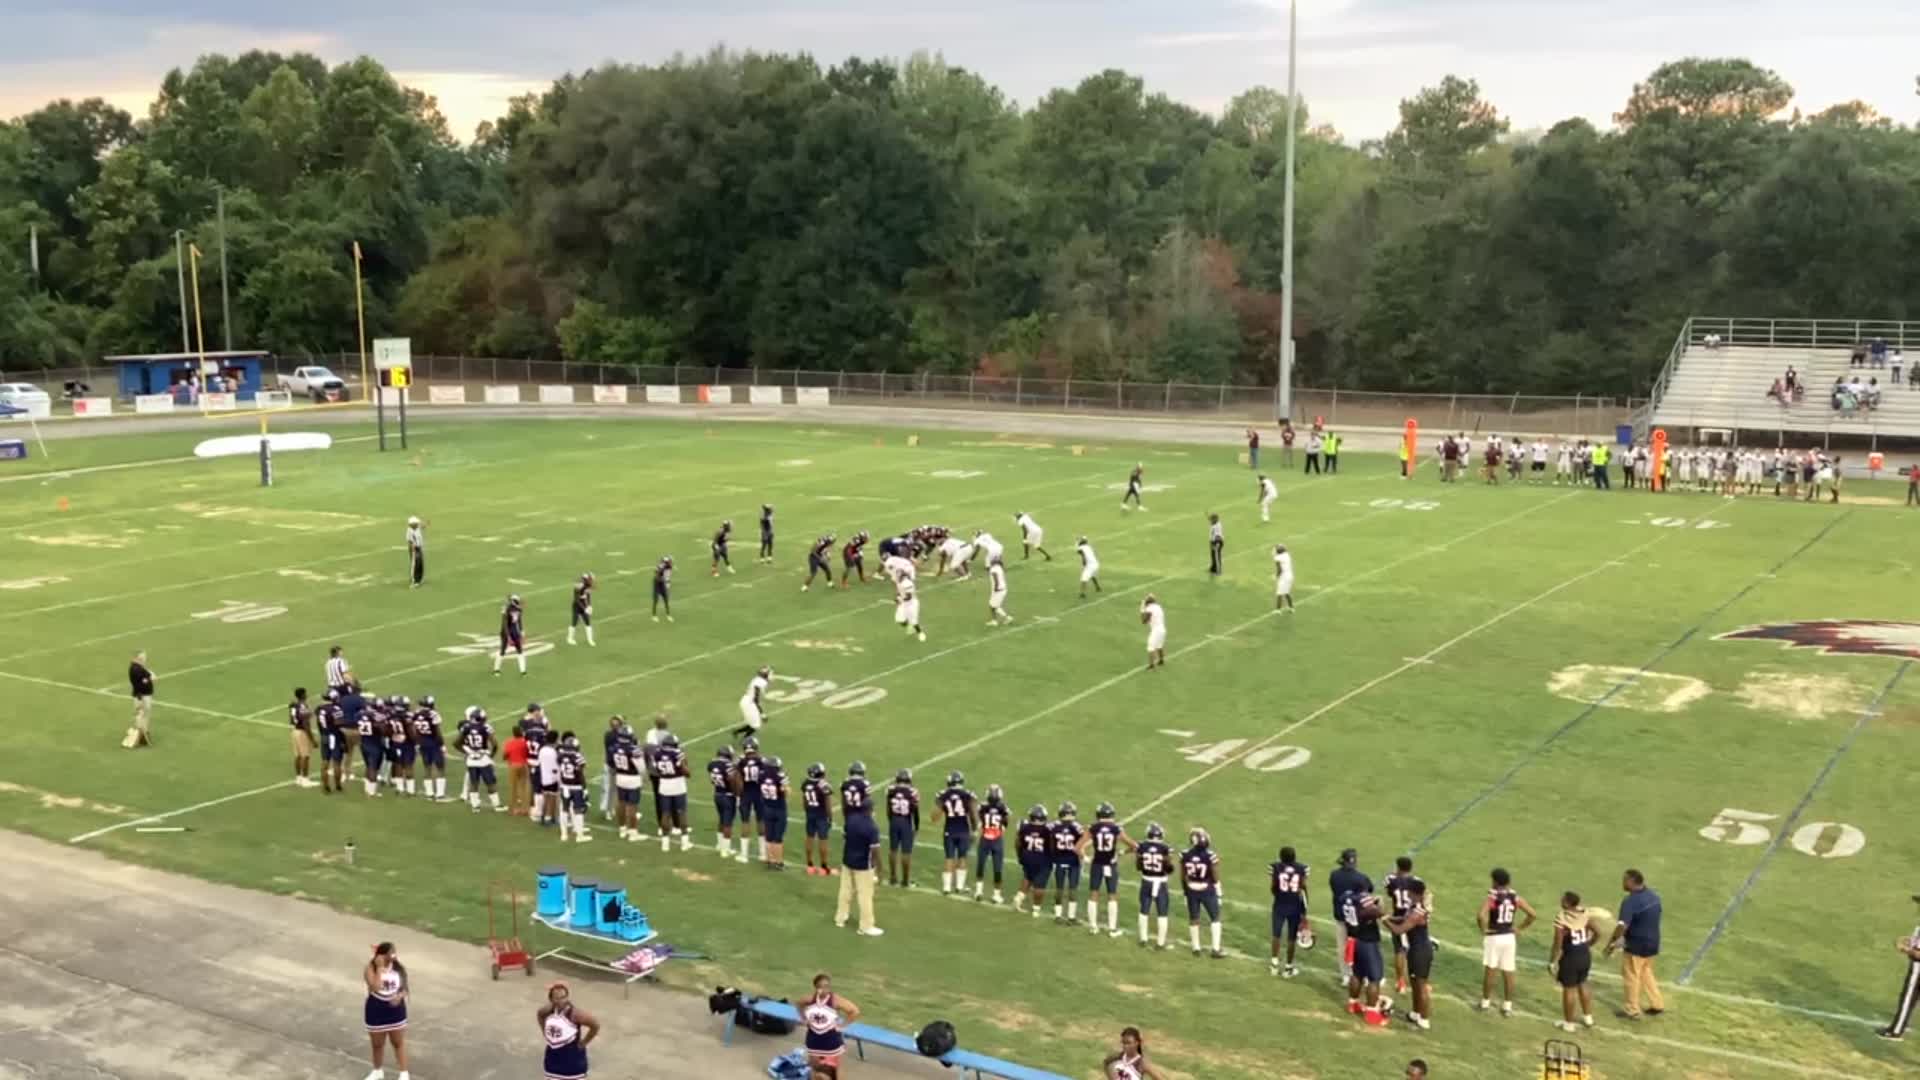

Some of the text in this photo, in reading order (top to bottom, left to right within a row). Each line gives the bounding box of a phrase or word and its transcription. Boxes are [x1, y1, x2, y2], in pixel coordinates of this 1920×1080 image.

[766, 679, 887, 709] 30
[1176, 738, 1311, 772] 40
[945, 800, 965, 817] 14
[984, 814, 1002, 828] 15
[1096, 833, 1114, 851] 13
[1699, 808, 1866, 857] 50
[1142, 852, 1163, 872] 25
[1185, 863, 1207, 878] 27
[1279, 873, 1299, 892] 64
[1497, 904, 1515, 923] 16
[1570, 928, 1587, 945] 51
